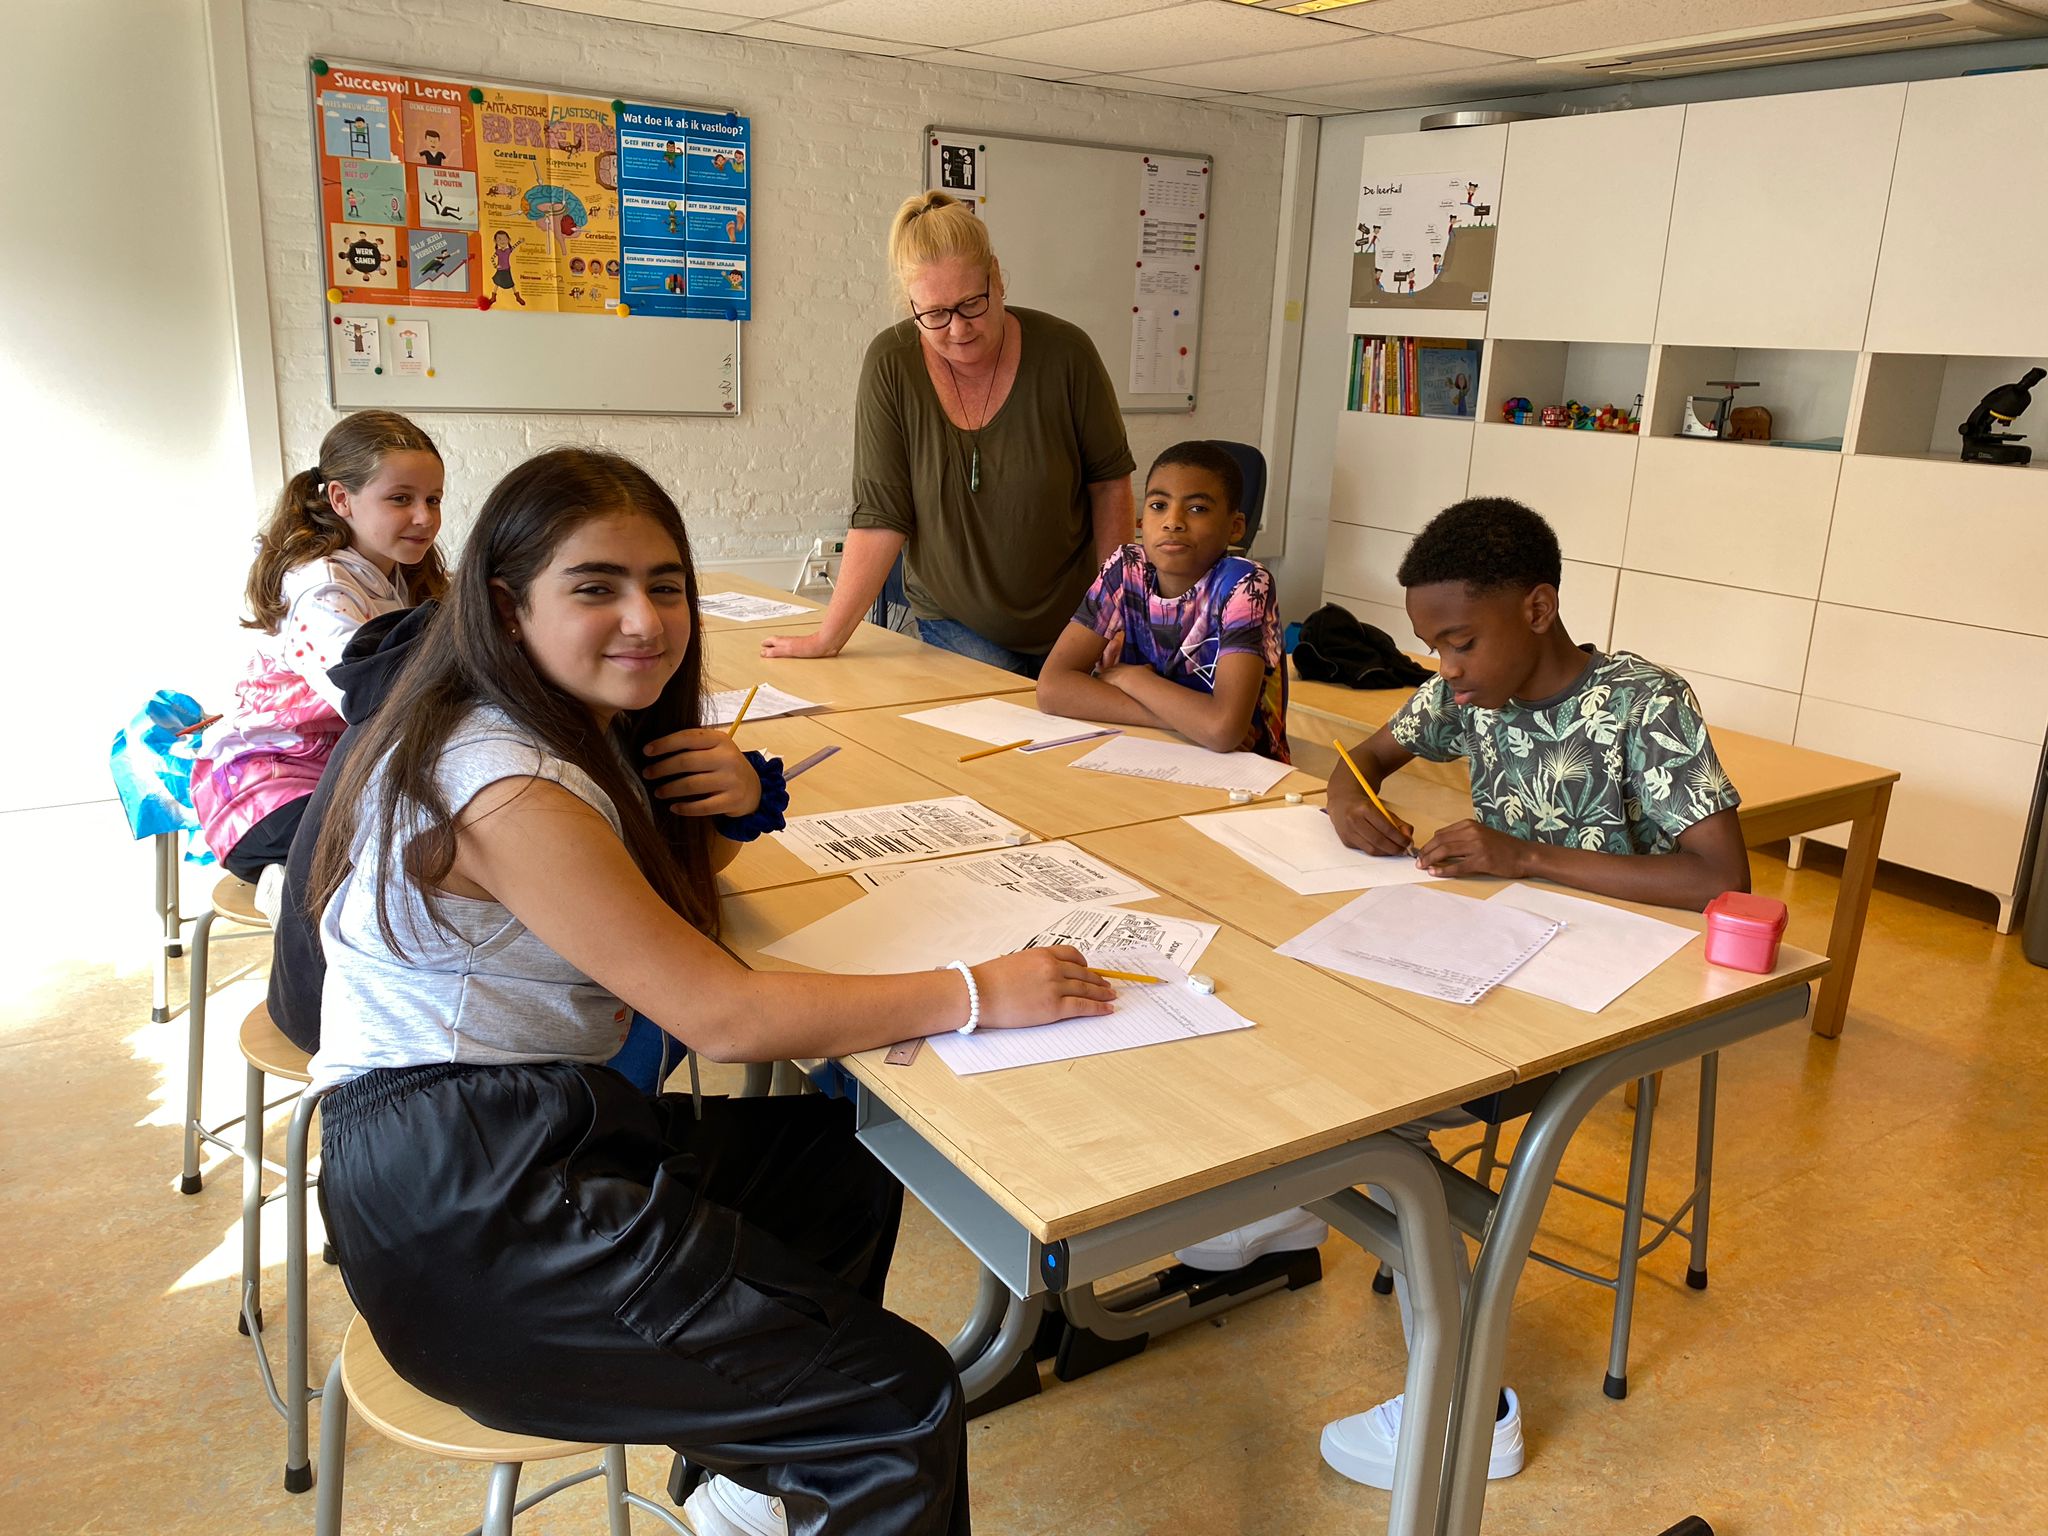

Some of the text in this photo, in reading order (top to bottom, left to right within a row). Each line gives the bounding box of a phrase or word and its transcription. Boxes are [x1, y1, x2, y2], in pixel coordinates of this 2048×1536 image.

[333, 72, 462, 102] Succesvol Leren
[623, 113, 744, 136] Wat doe ik als ik vastloop?
[481, 113, 617, 153] BREIN
[494, 149, 537, 160] Cerebrum
[1363, 186, 1375, 195] De
[585, 232, 617, 240] Cerebellum
[355, 247, 374, 255] WERK
[355, 257, 376, 265] SAMEN
